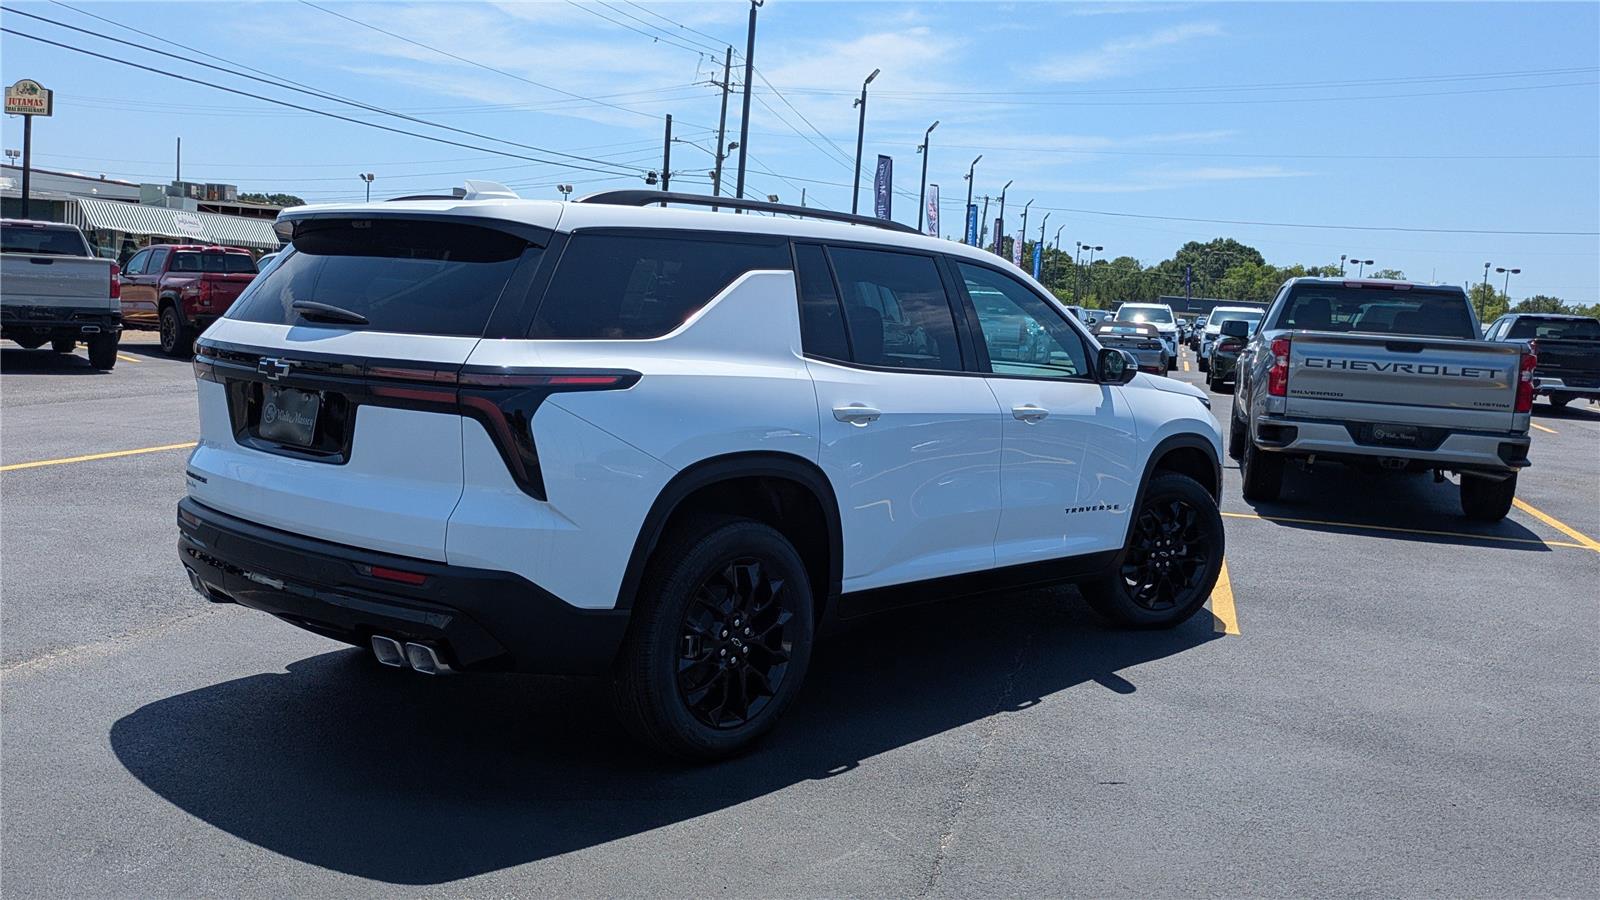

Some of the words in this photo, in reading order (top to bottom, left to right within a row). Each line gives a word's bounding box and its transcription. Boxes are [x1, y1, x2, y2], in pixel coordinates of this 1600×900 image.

[8, 97, 44, 106] JUTAMAS
[1305, 358, 1503, 379] CHEVROLET
[1291, 389, 1344, 397] SILVERADO
[1065, 504, 1120, 514] TRAVERSE
